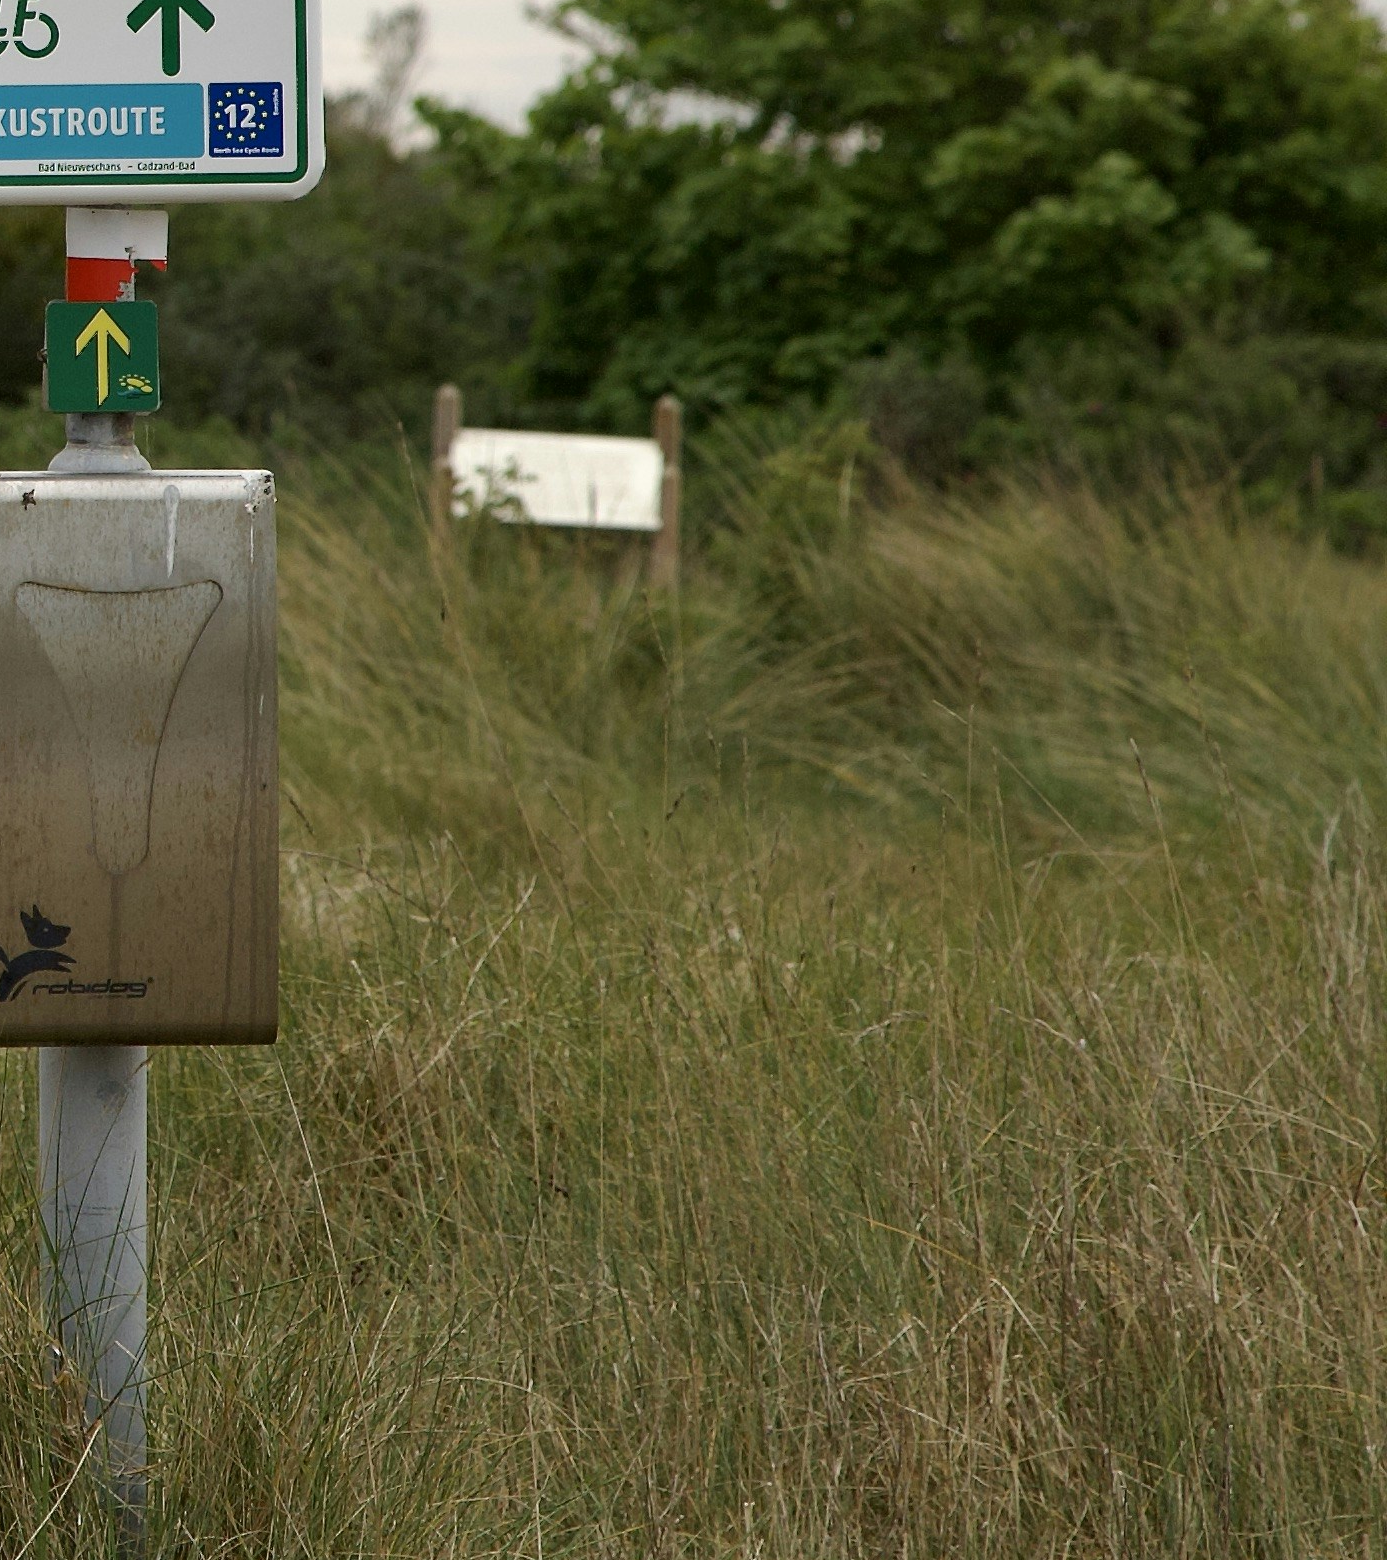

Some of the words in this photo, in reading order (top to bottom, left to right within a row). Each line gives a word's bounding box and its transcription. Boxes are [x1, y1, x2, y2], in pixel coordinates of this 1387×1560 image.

[224, 103, 257, 129] 12
[38, 163, 55, 172] Bad
[32, 978, 147, 999] robidog
